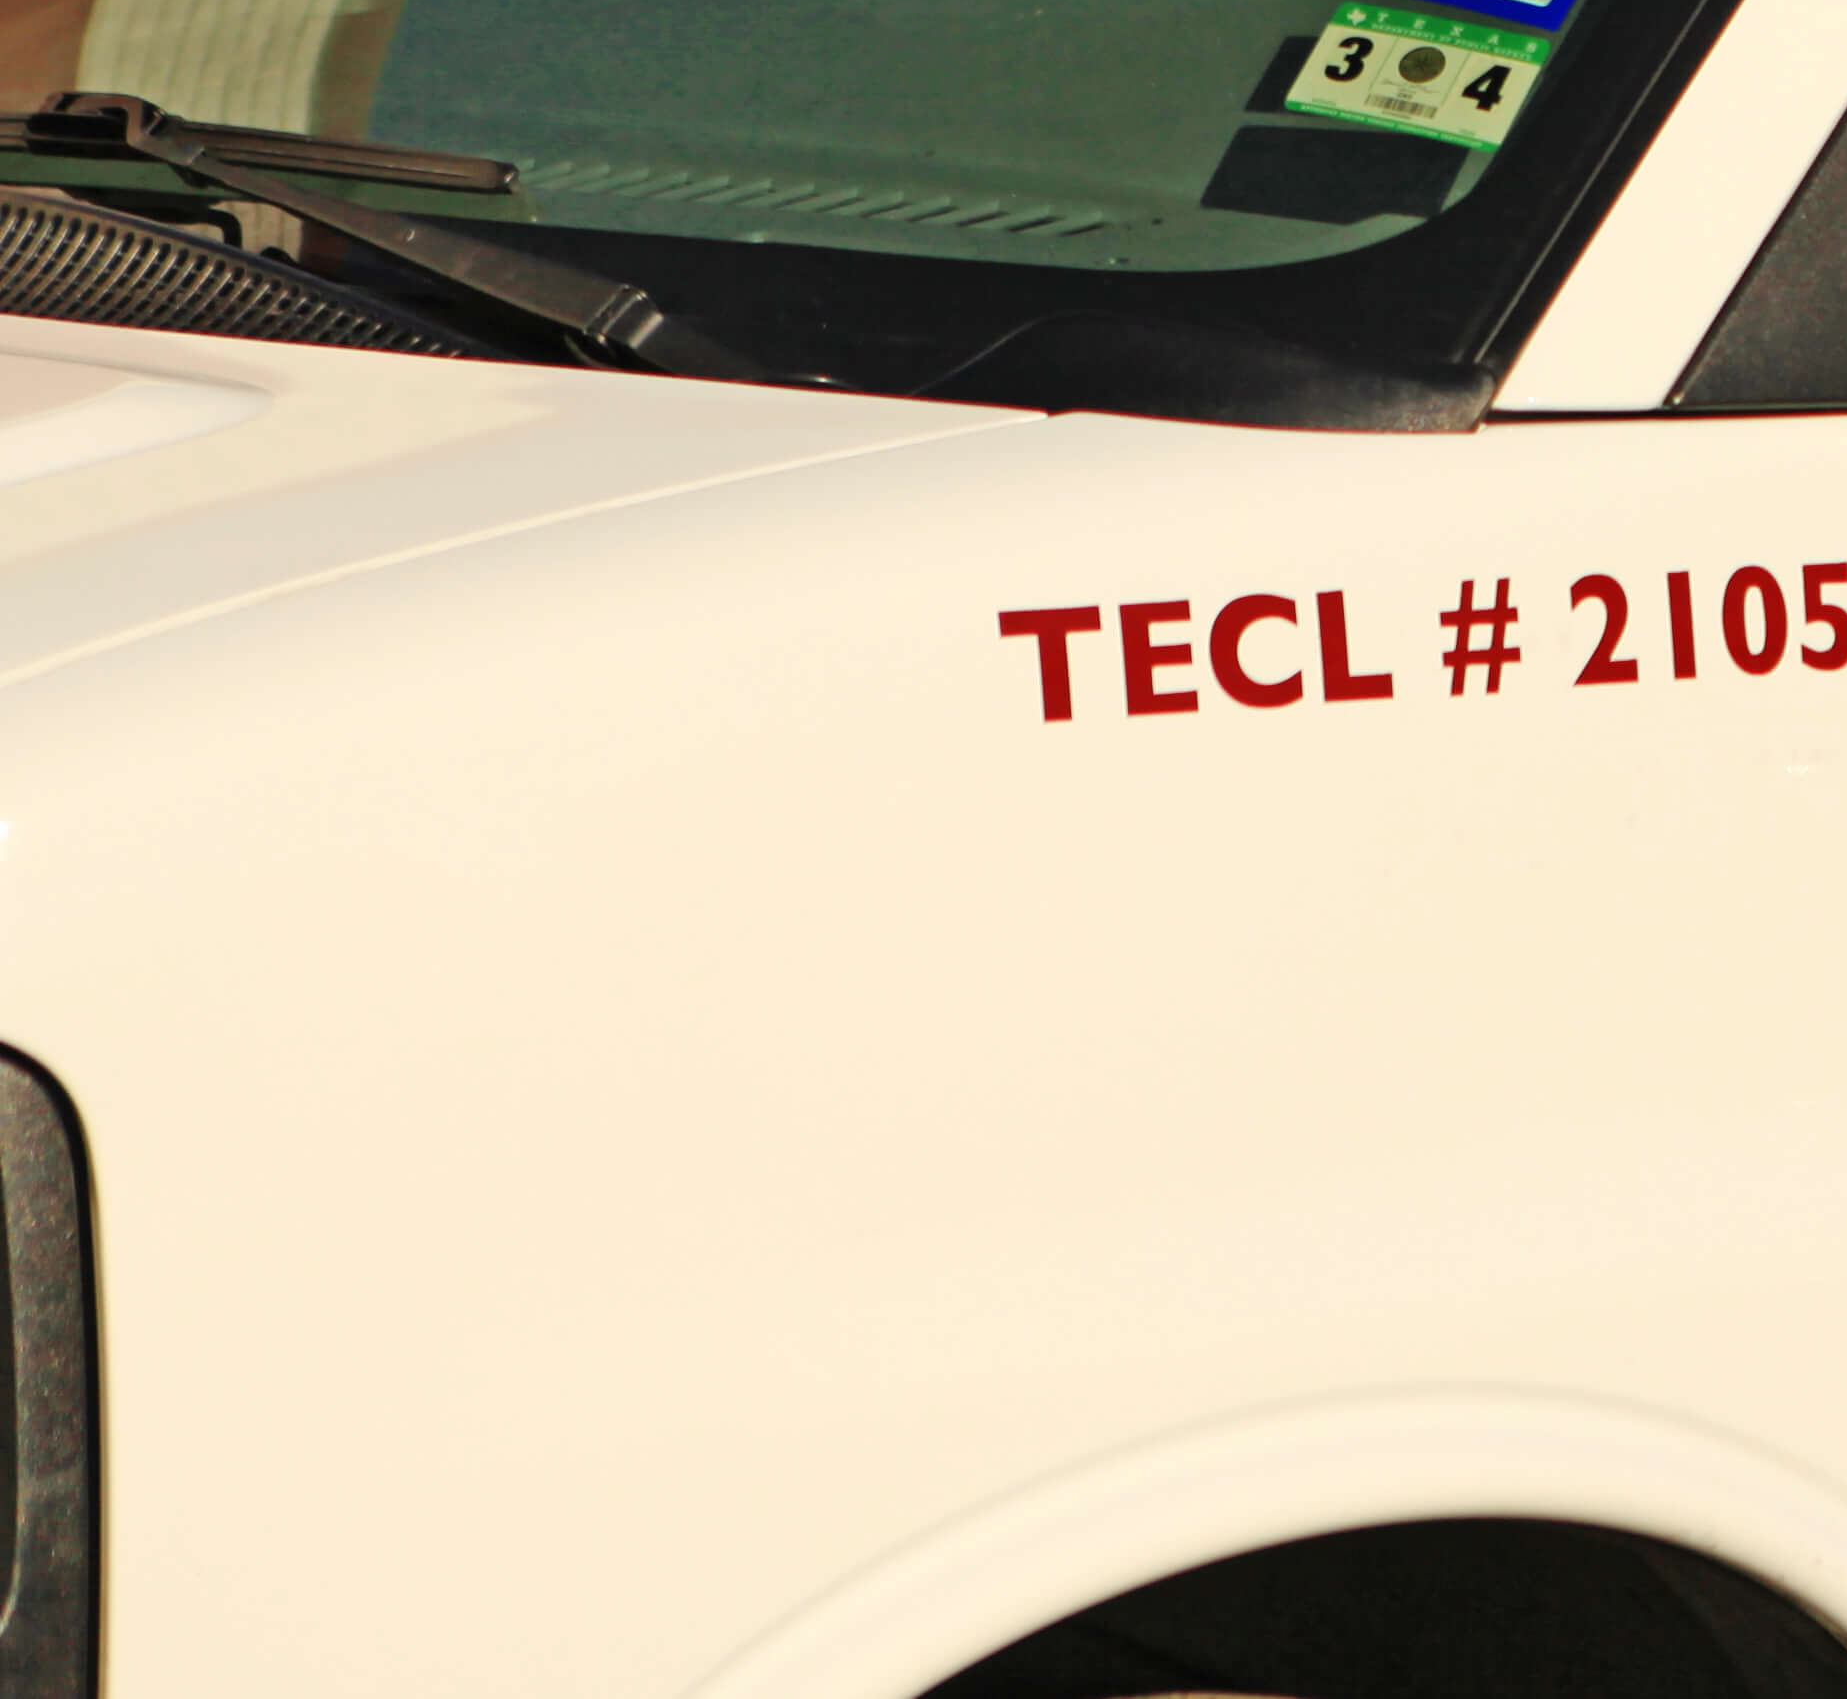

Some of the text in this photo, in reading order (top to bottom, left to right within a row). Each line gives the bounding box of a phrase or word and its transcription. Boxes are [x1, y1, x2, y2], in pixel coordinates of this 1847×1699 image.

[1324, 36, 1512, 113] 3 4
[999, 590, 1394, 723] TECL
[1439, 577, 1522, 698] #
